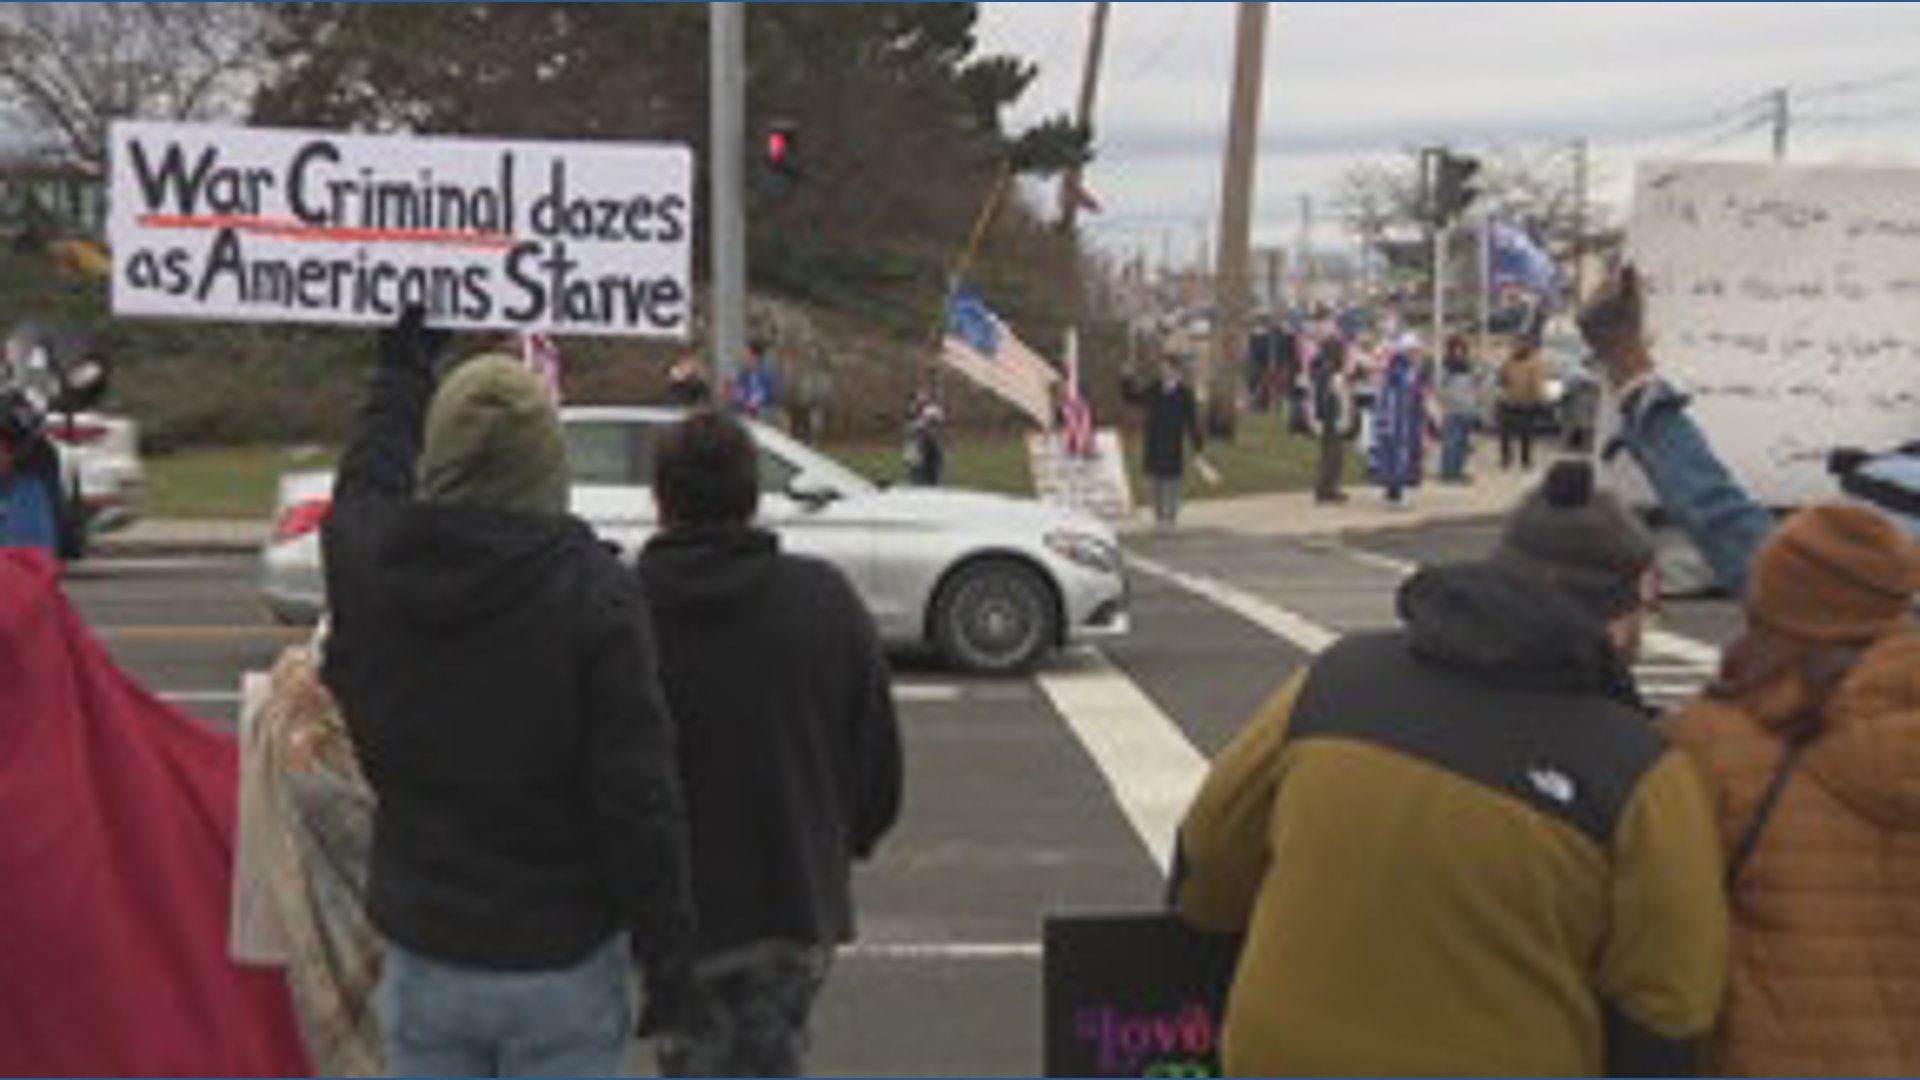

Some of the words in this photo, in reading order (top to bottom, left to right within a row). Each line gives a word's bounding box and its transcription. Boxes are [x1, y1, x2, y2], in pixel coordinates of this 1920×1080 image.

[127, 138, 274, 215] War
[287, 140, 512, 236] Criminal
[530, 157, 685, 242] dozes
[126, 247, 192, 295] as
[197, 228, 493, 320] Americans
[503, 241, 684, 328] Starve
